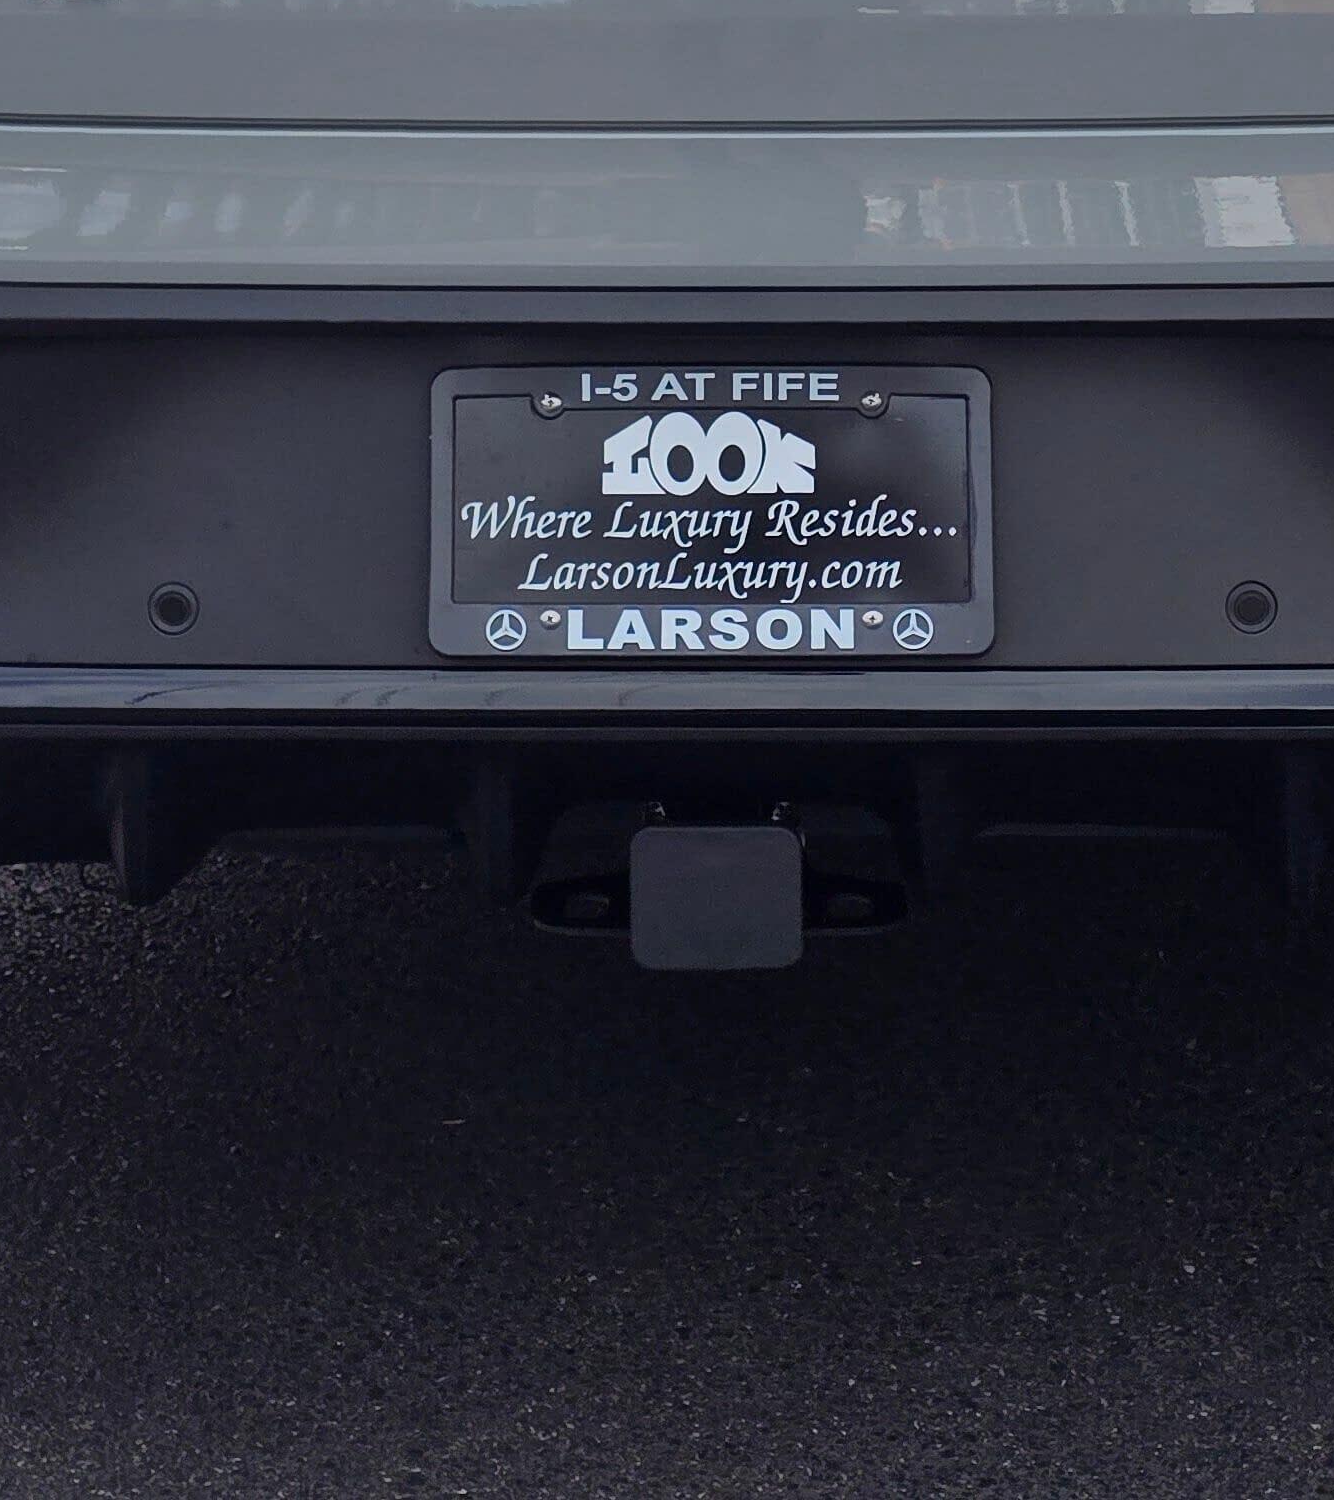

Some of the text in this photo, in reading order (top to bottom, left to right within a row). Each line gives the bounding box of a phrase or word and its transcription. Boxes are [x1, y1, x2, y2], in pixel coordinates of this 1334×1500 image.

[581, 372, 840, 403] I-5 AT FIFE
[601, 411, 817, 497] LOOK
[460, 493, 958, 554] Where Luxury Resides...
[517, 552, 904, 604] LarsonLuxury.com
[566, 607, 856, 651] LARSON
